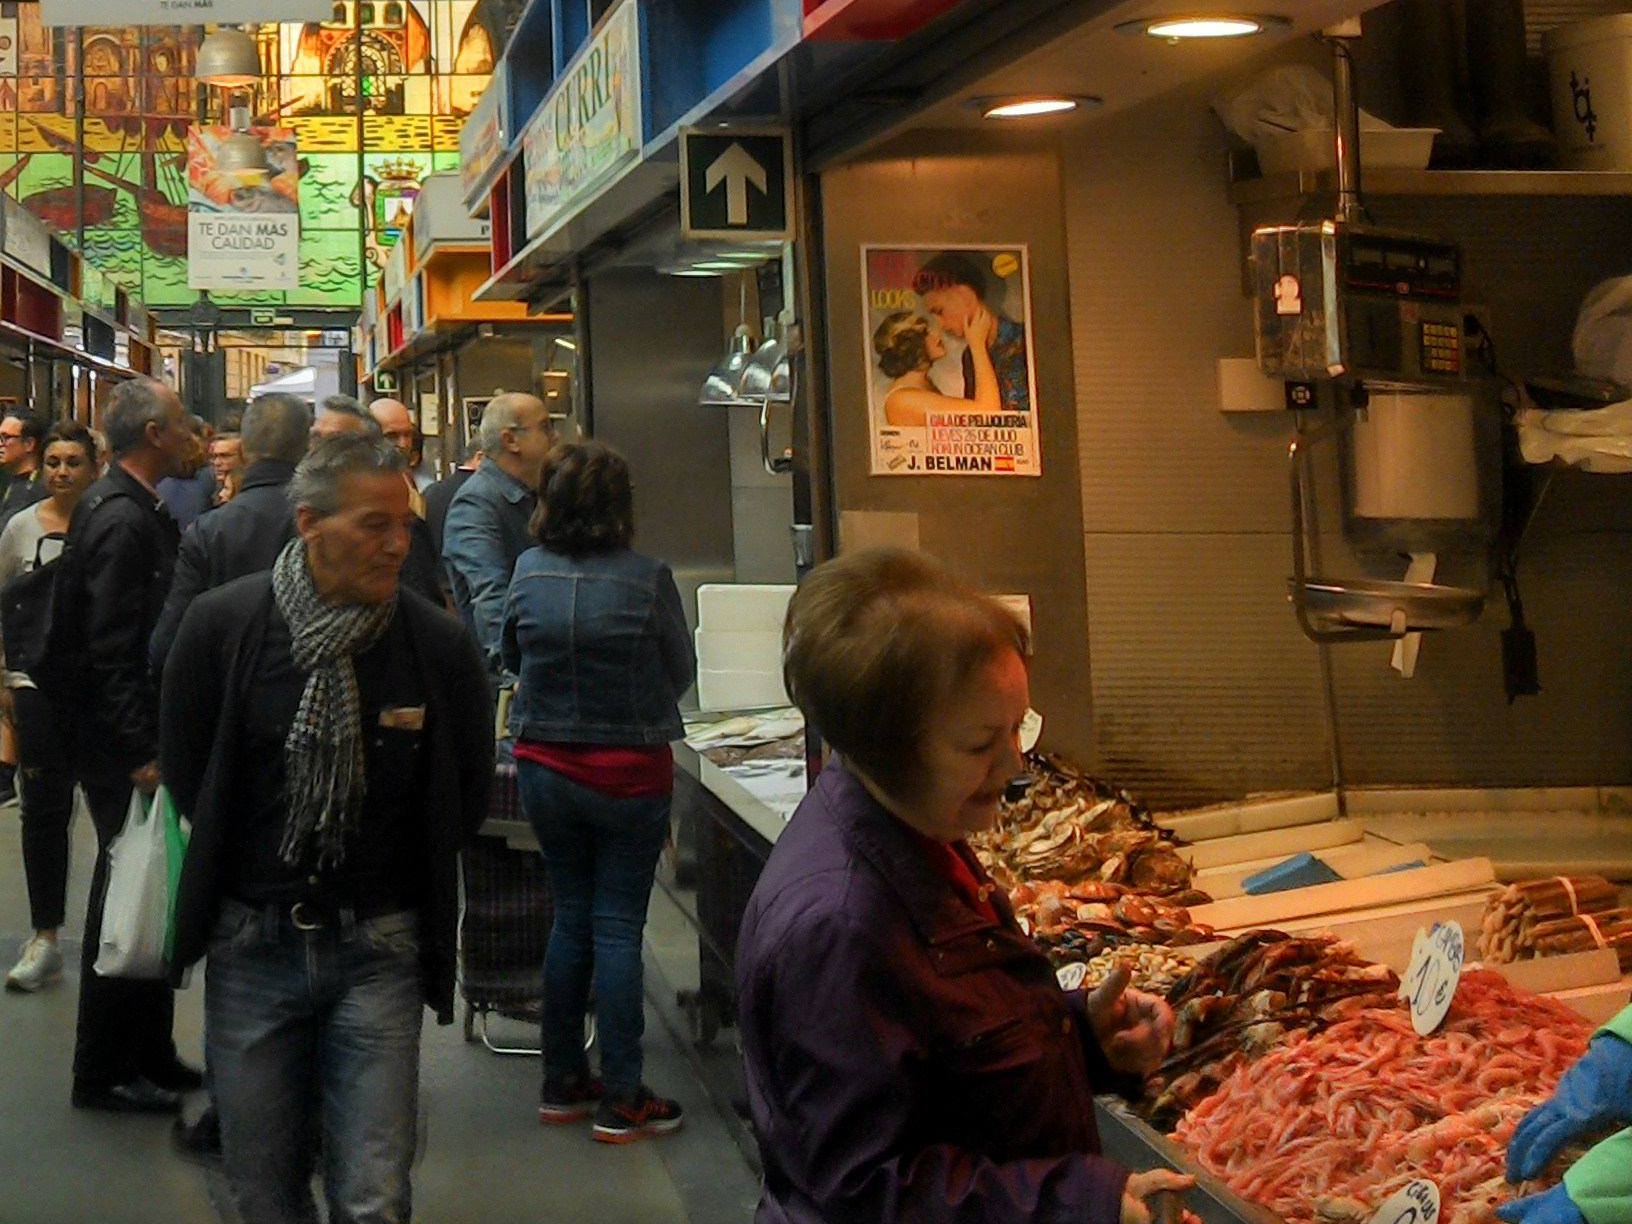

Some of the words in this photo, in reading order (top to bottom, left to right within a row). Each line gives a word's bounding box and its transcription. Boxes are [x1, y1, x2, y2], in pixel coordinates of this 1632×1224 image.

[199, 222, 213, 236] TE
[218, 222, 252, 236] DAN
[211, 236, 275, 250] CALIDAD
[908, 456, 921, 470] J.
[925, 456, 992, 471] BELMAN
